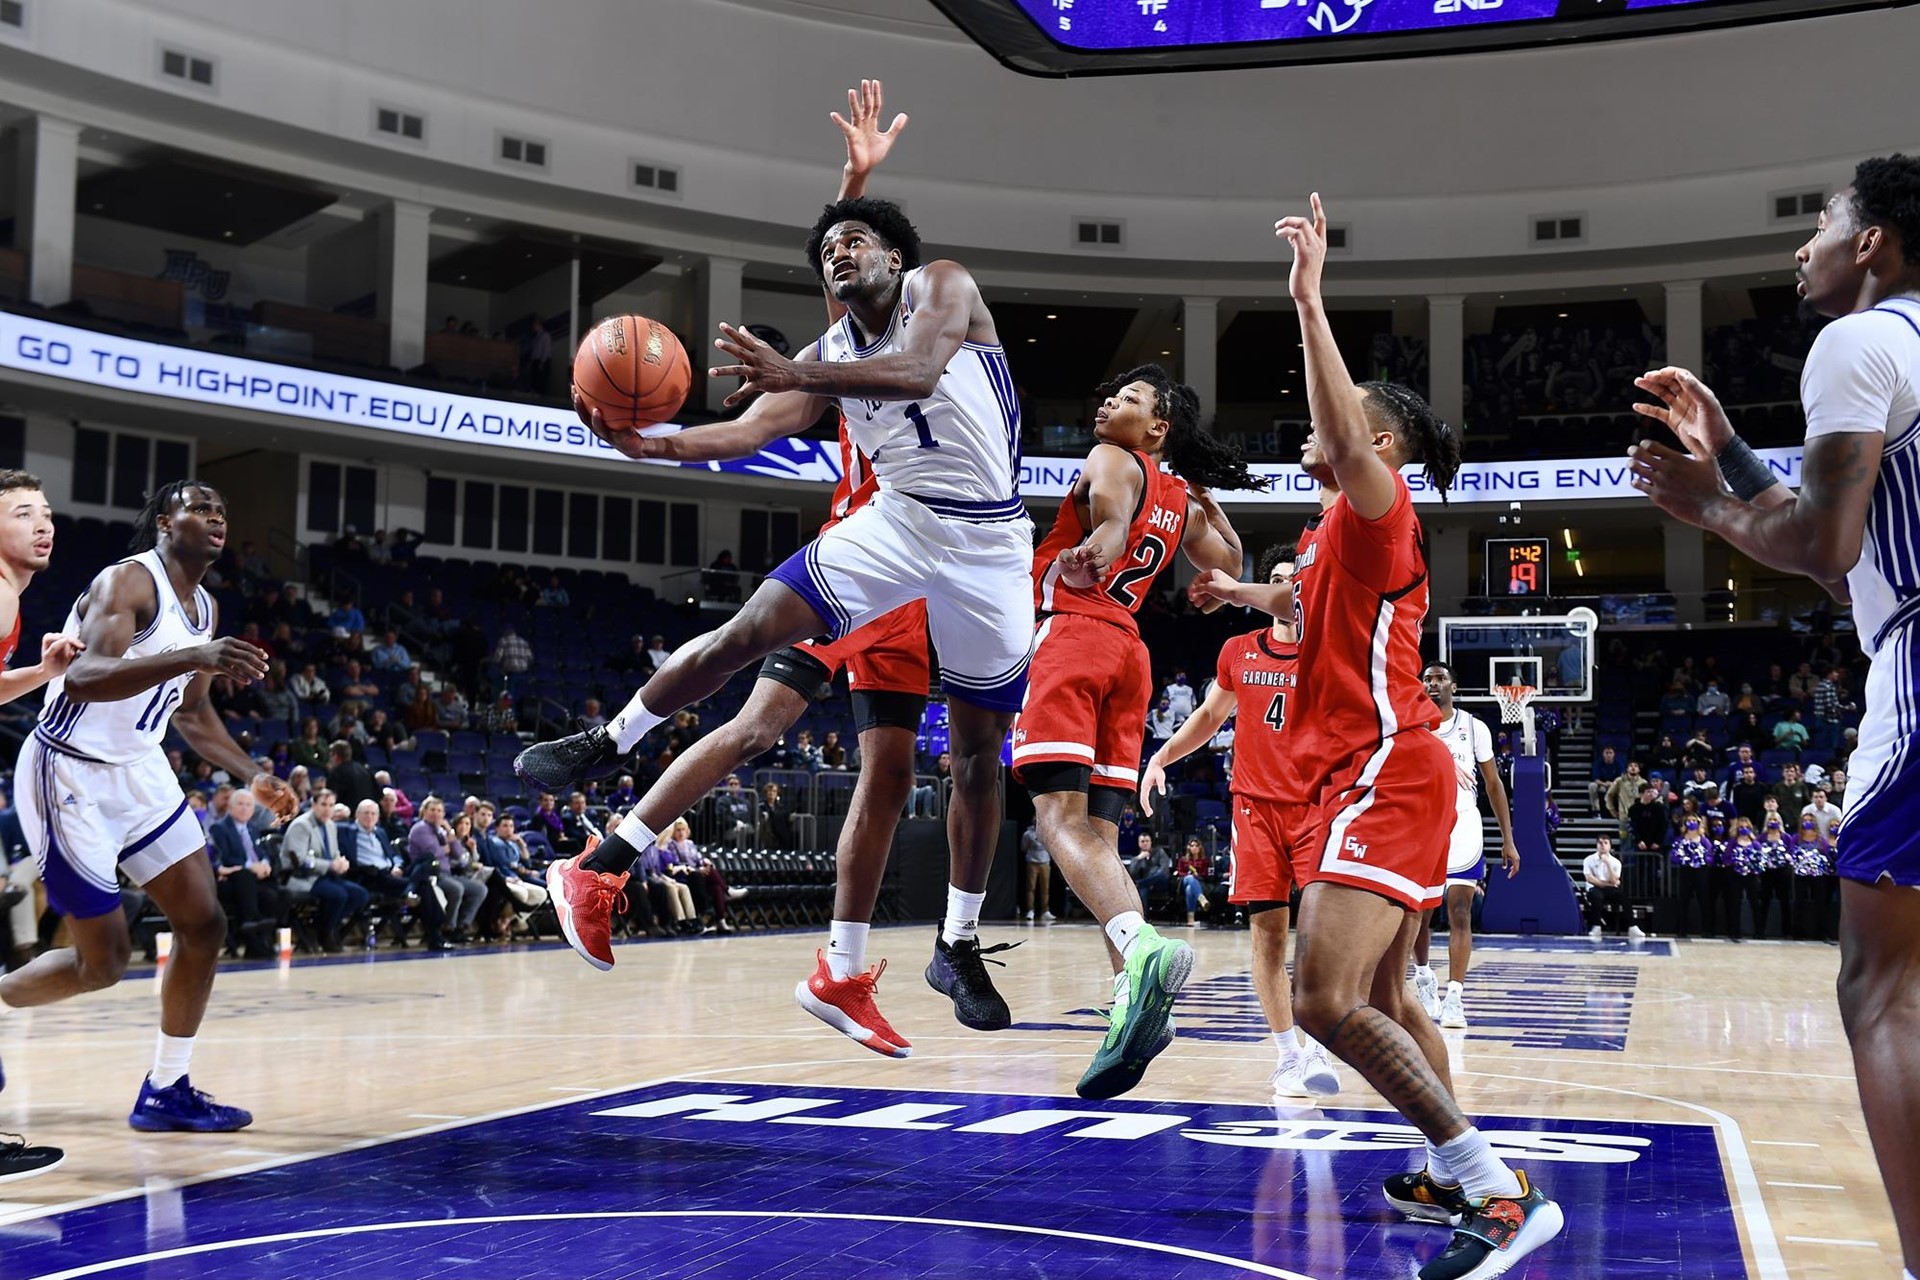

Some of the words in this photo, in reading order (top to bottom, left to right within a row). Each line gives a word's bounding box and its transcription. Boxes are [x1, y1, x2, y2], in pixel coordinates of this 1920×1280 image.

[1153, 20, 1167, 32] 4
[18, 335, 71, 366] GO
[91, 349, 140, 379] TO
[903, 402, 941, 448] 1
[1020, 466, 1082, 485] DINA
[1510, 545, 1541, 562] 1:42
[1104, 533, 1166, 608] 2
[1511, 563, 1536, 591] 19
[1242, 670, 1297, 688] GARDNER-W
[1264, 692, 1286, 731] 4
